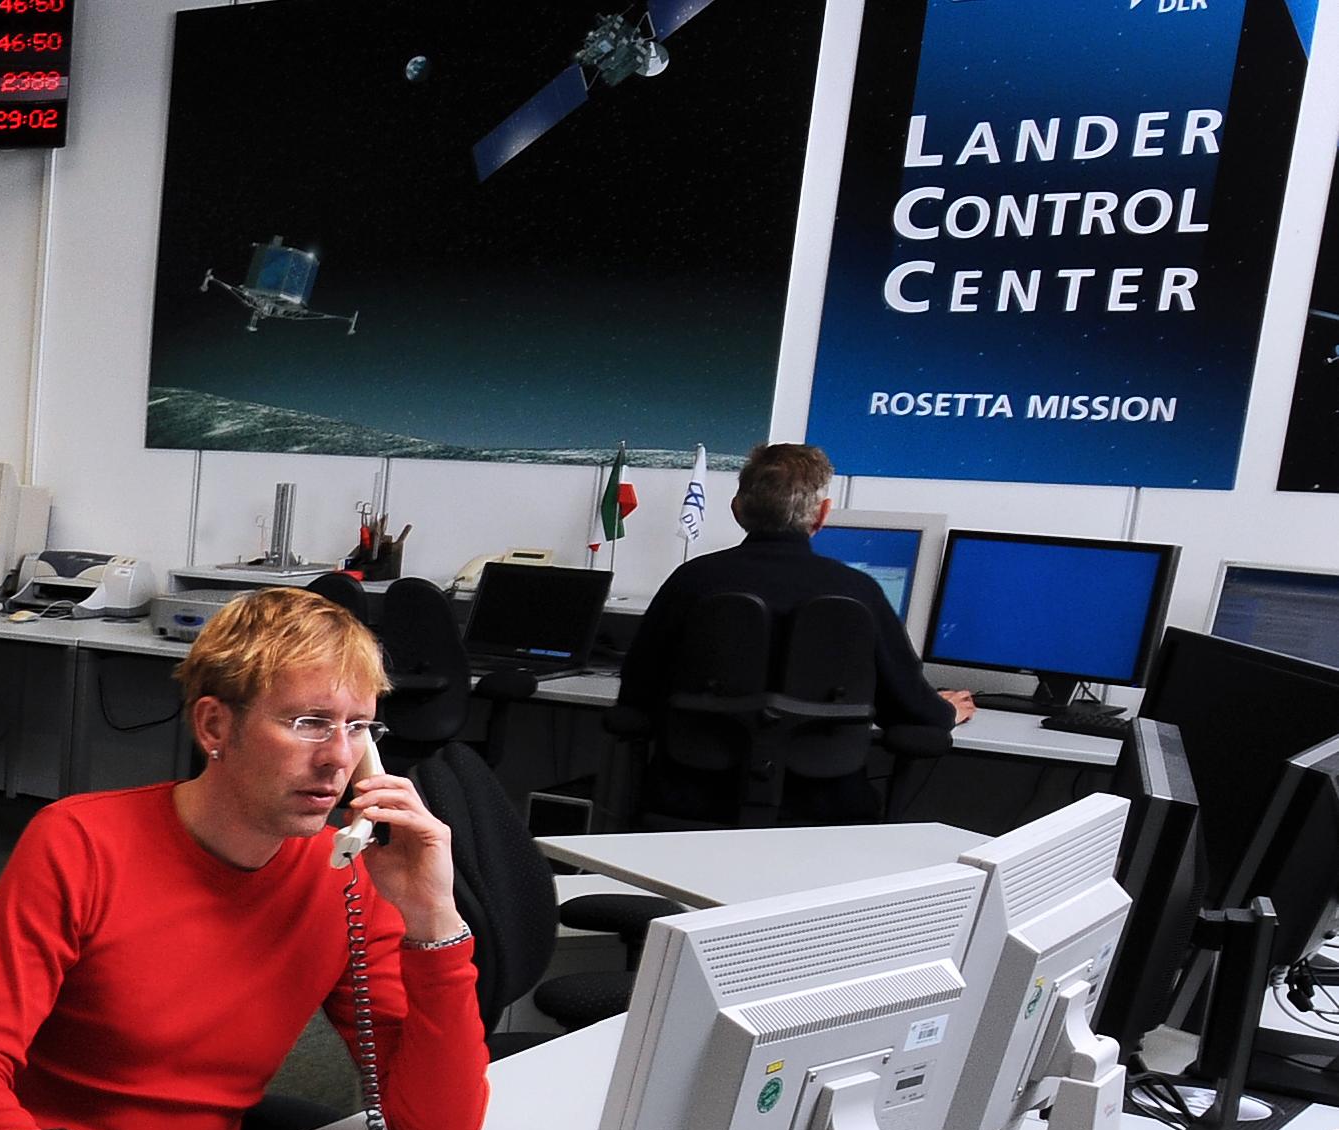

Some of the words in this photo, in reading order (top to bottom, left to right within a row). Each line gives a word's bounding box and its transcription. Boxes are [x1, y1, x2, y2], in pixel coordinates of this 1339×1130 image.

[903, 108, 1224, 168] LANDER
[892, 186, 1210, 240] CONTROL
[883, 259, 1200, 314] CENTER
[868, 391, 1014, 419] ROSETTA
[1026, 394, 1178, 422] MISSION
